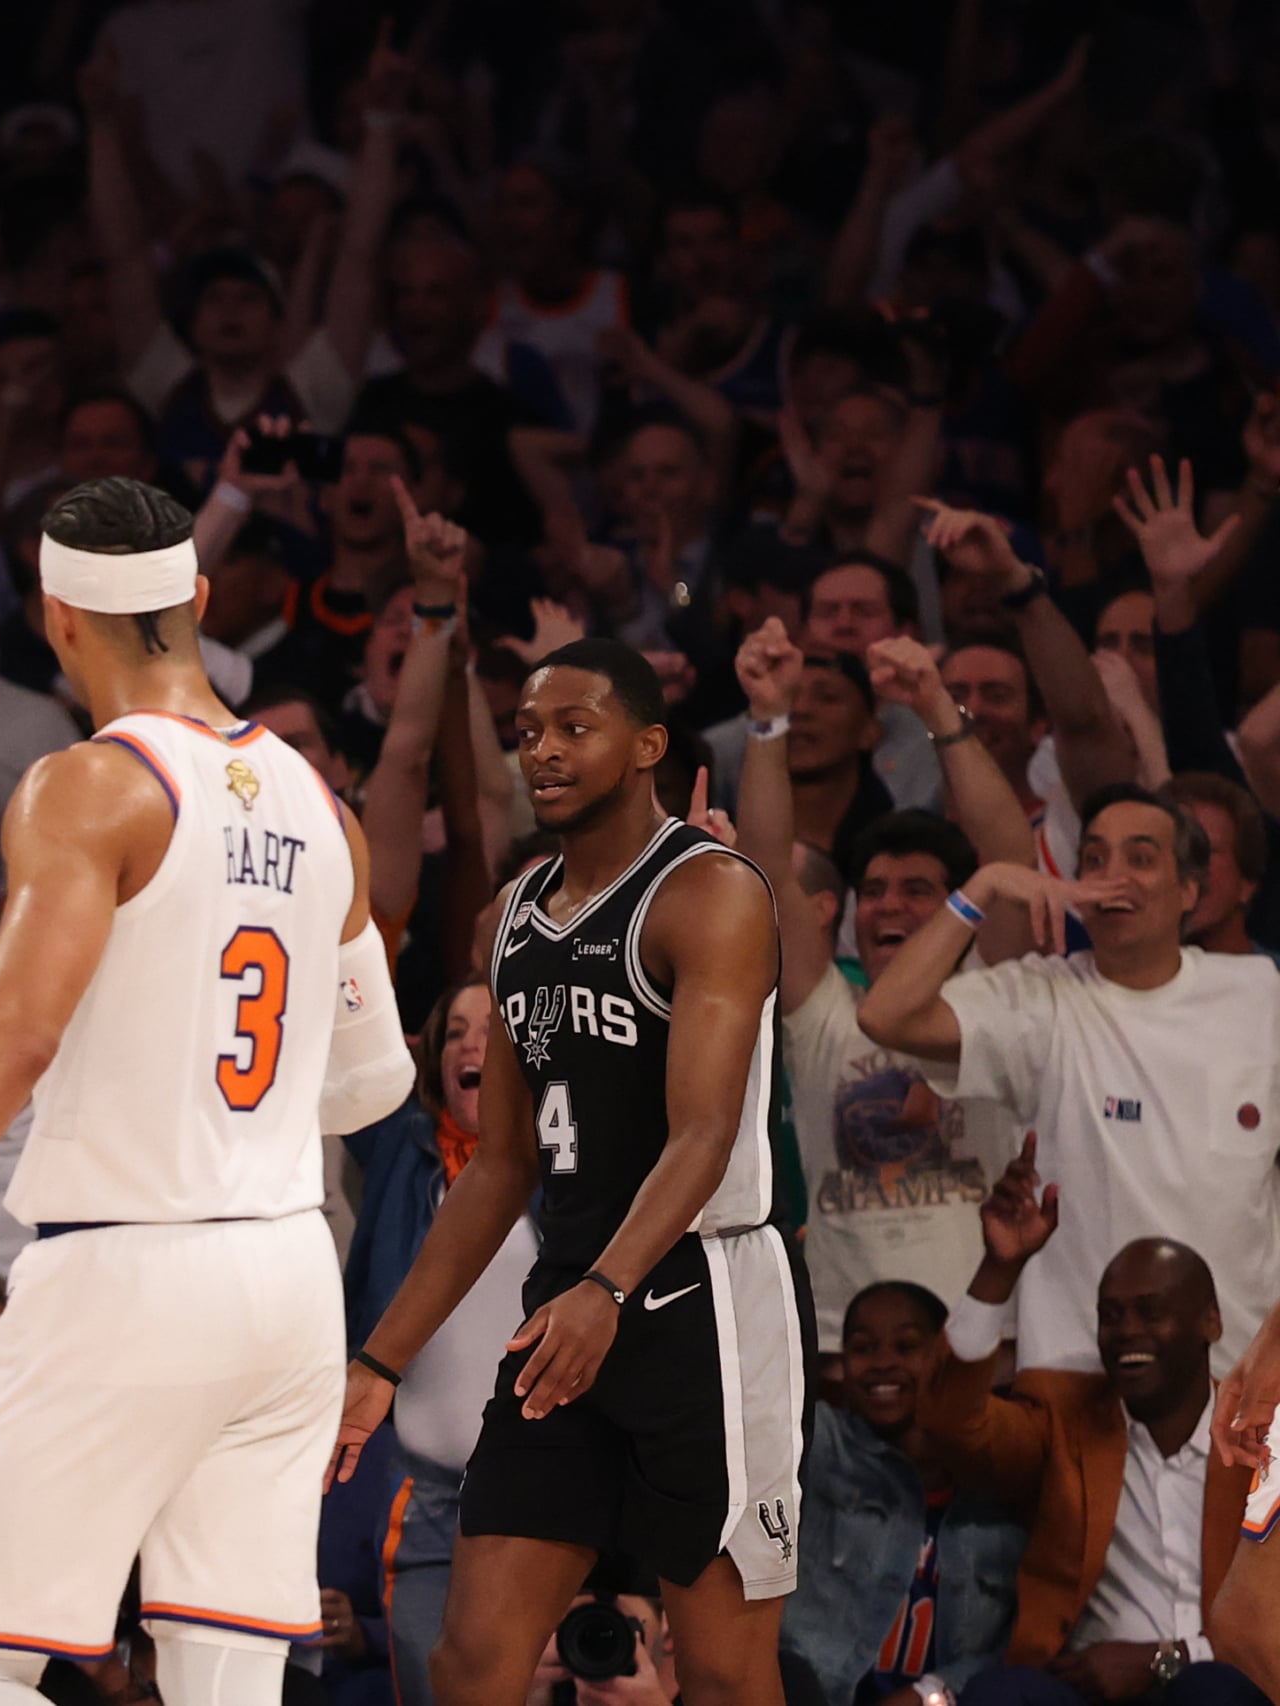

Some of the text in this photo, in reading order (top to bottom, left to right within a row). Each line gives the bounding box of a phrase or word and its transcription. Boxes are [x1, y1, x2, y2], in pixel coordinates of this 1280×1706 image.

[223, 826, 306, 894] HART
[577, 943, 613, 955] LEDGER
[215, 925, 290, 1112] 3
[535, 1080, 578, 1175] 4
